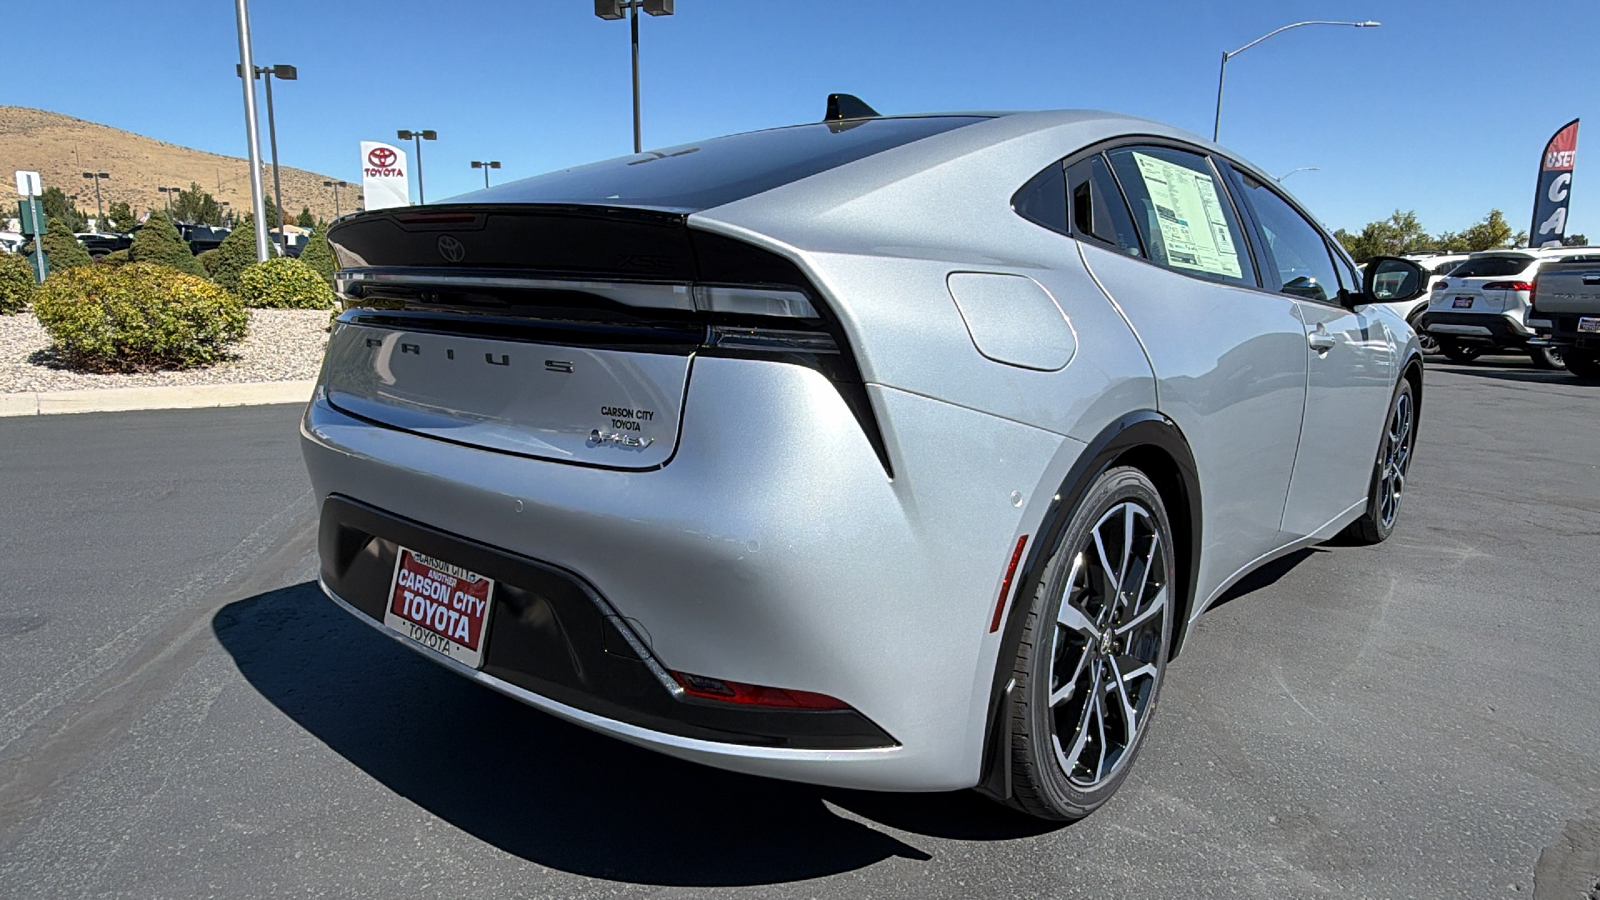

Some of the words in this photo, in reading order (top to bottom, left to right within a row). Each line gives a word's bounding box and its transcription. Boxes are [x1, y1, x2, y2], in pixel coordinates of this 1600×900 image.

[364, 168, 404, 177] TOYOTA
[366, 338, 574, 373] PRIUS
[601, 406, 634, 418] CARSON
[636, 409, 654, 421] CITY
[611, 419, 641, 431] TOYOTA
[419, 554, 449, 572] CARSON
[427, 569, 457, 586] ANOTHER
[398, 568, 451, 604] CARSON
[453, 591, 486, 618] CITY
[403, 591, 470, 643] TOYOTA
[409, 623, 451, 655] TOYOTA
